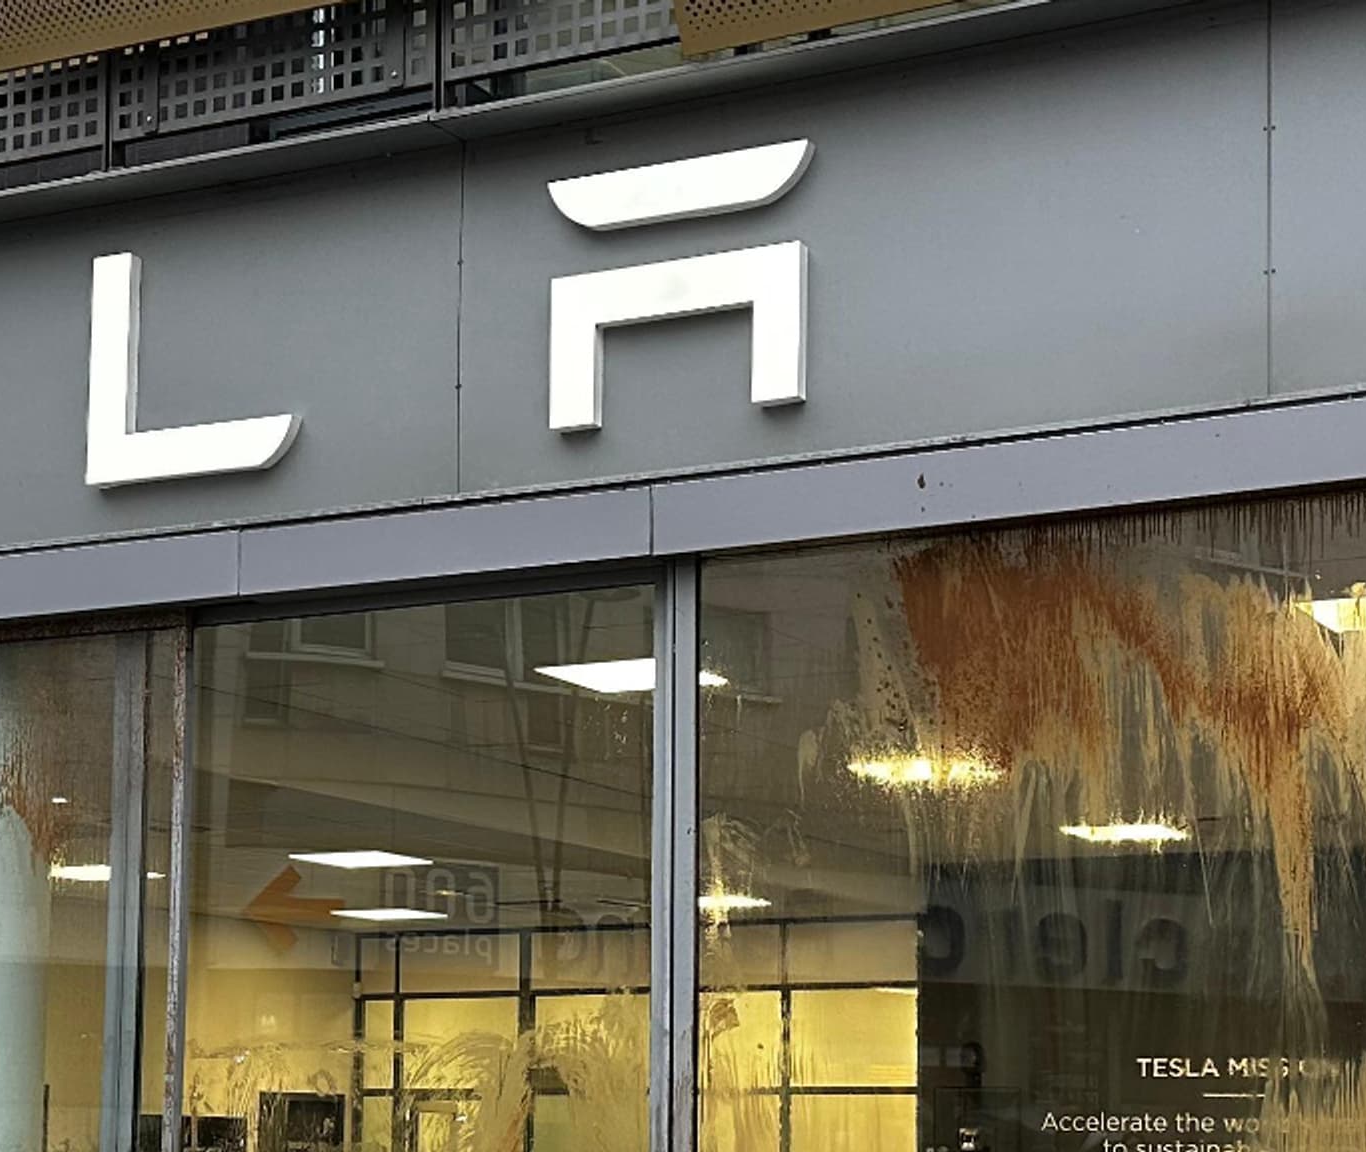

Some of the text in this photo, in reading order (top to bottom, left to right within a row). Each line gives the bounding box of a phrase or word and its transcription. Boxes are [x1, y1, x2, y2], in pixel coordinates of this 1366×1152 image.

[1136, 1057, 1220, 1078] TESLA
[1040, 1111, 1168, 1133] Accelerate
[1174, 1112, 1215, 1133] the
